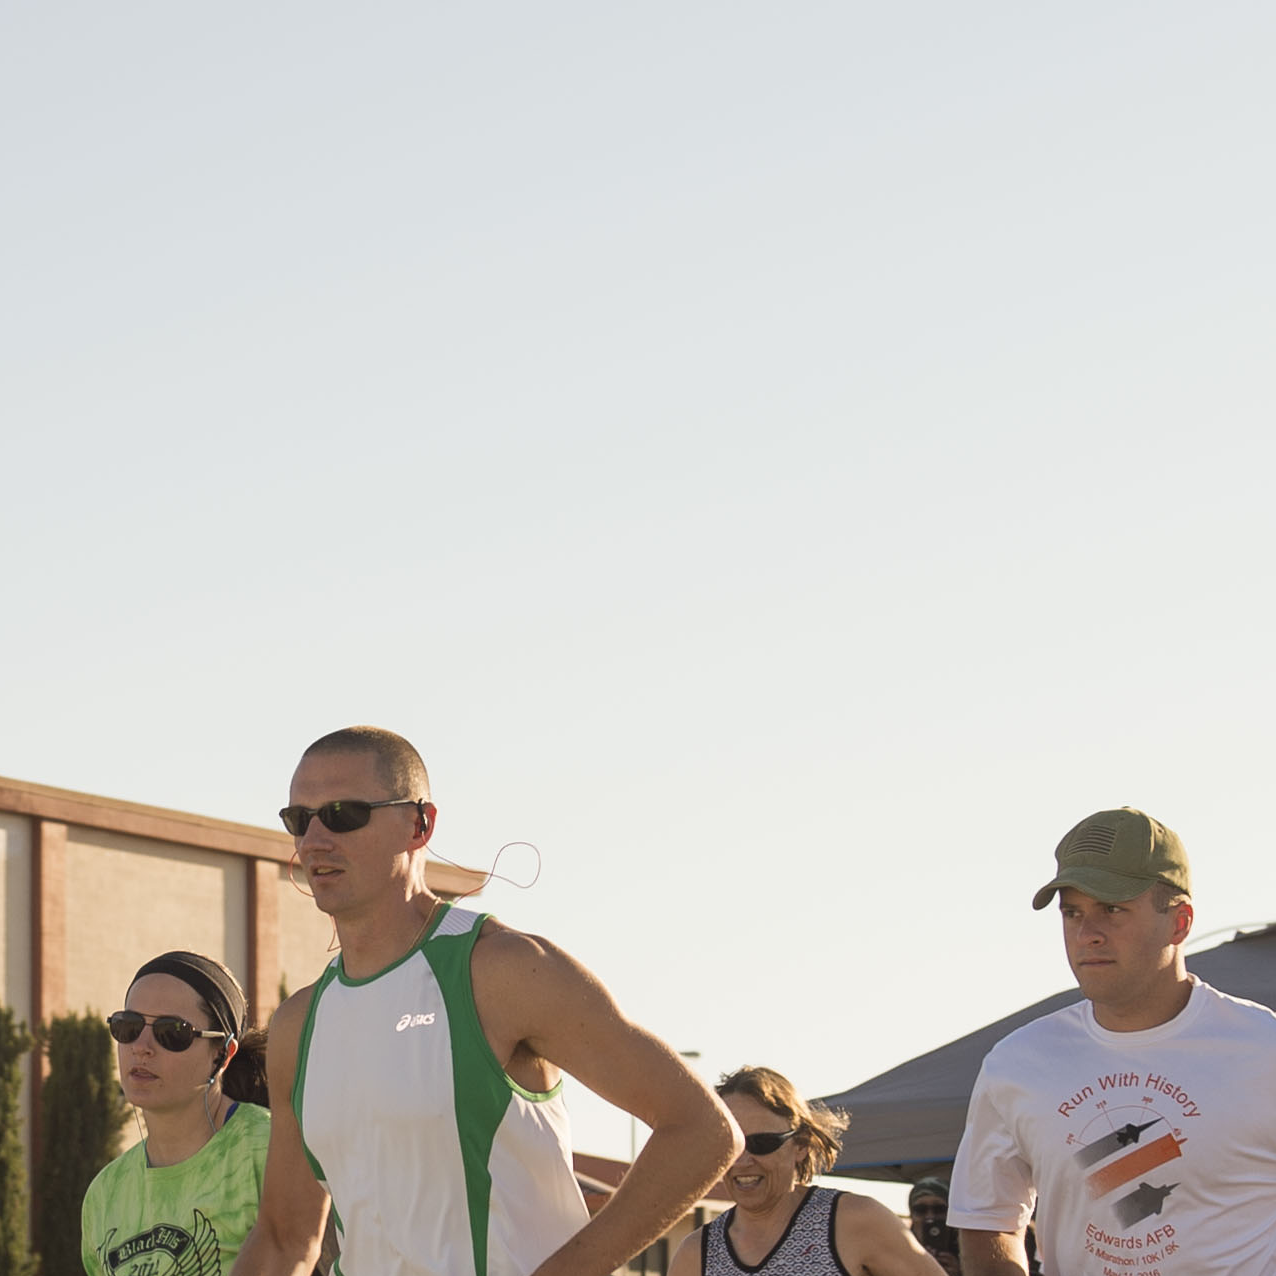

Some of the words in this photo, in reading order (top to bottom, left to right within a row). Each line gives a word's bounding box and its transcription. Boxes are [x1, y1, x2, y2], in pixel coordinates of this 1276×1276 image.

[1057, 1086, 1094, 1118] Run
[1097, 1072, 1140, 1091] With
[1145, 1073, 1201, 1117] History
[1085, 1223, 1143, 1249] Edwards
[1146, 1224, 1176, 1247] AFB
[1095, 1247, 1136, 1267] Marathon
[1142, 1251, 1161, 1265] 10K
[1165, 1240, 1180, 1255] 5K
